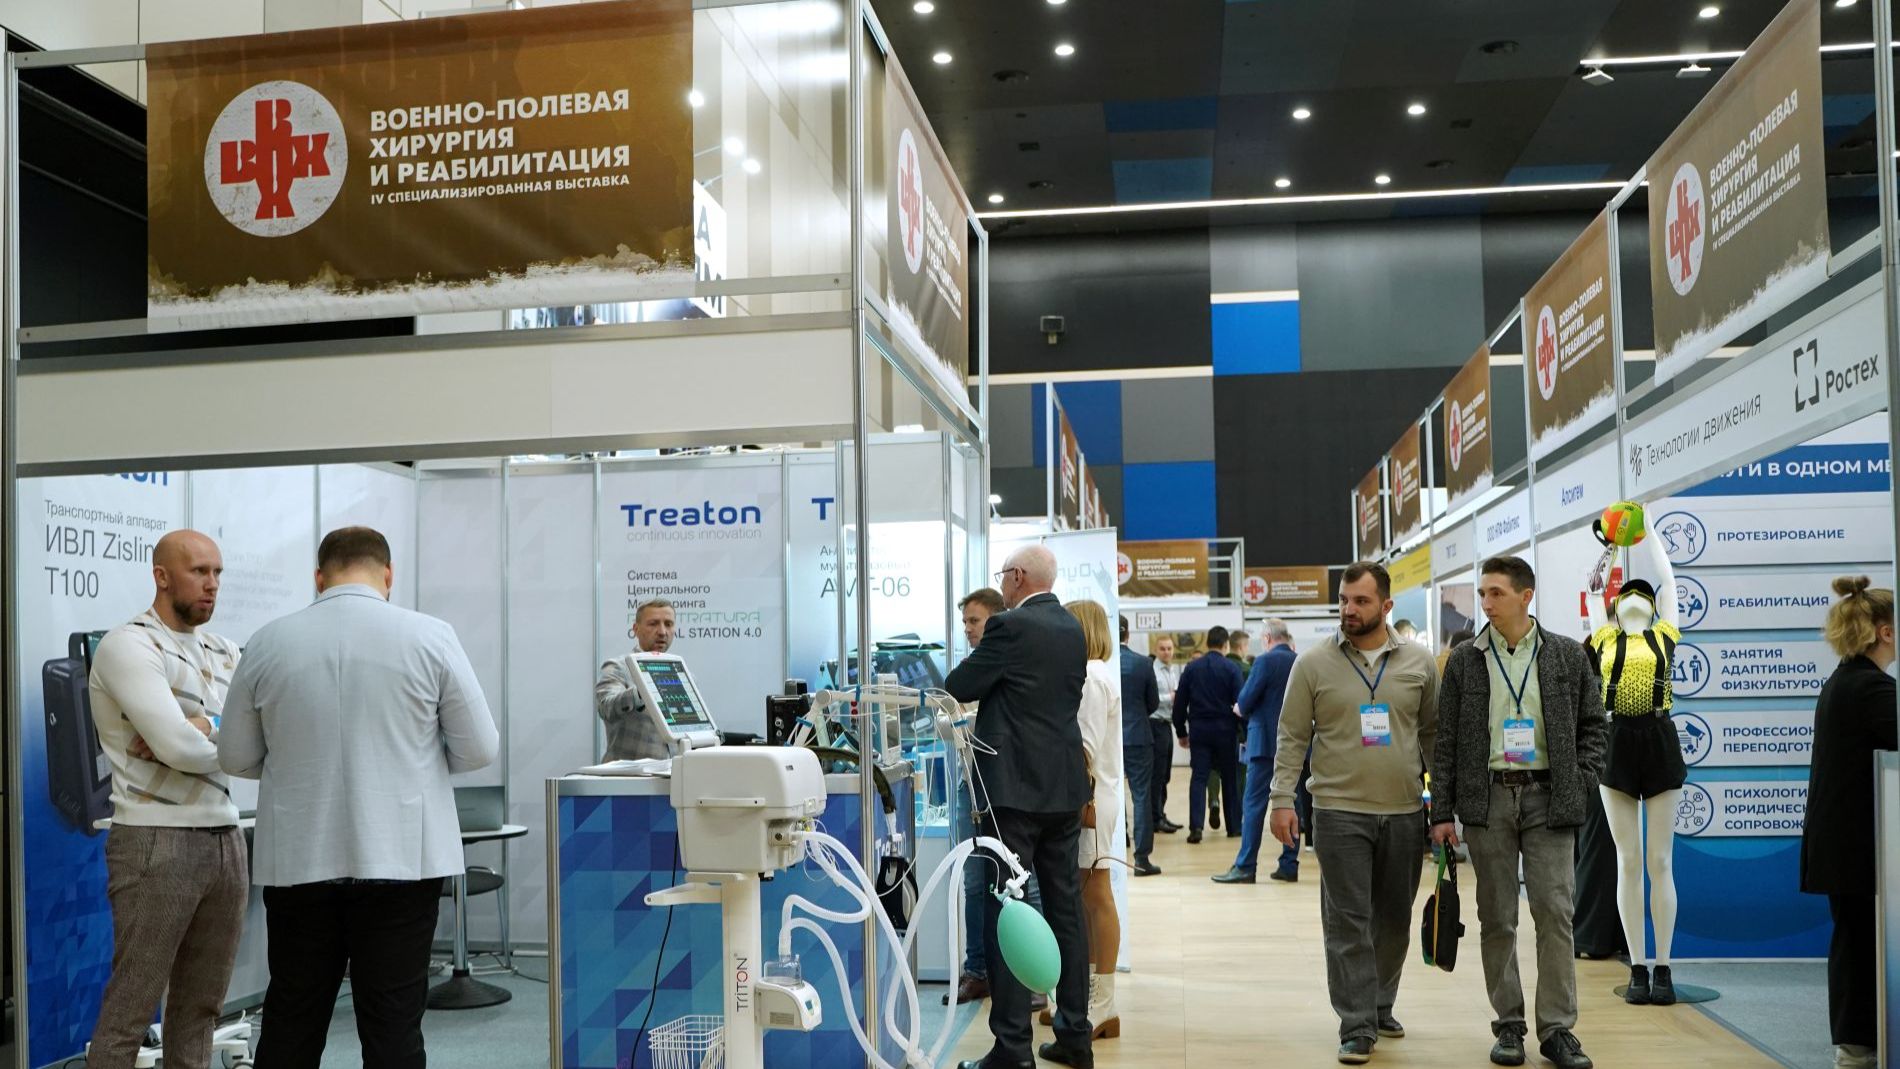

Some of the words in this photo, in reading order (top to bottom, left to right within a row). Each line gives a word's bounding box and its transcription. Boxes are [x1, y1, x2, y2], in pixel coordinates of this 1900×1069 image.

[370, 89, 629, 132] ВОЕННО-ПОЛЕВАЯ
[369, 126, 514, 159] ХИРУРГИЯ
[1709, 88, 1798, 188] ВОЕННО-ПОЛЕВАЯ
[370, 164, 389, 187] И
[397, 145, 630, 184] РЕАБИЛИТАЦИЯ
[370, 193, 384, 205] IV
[387, 180, 552, 204] СПЕЦИАЛИЗИРОВАННАЯ
[555, 174, 630, 191] ВЫСТАВКА
[1711, 153, 1758, 212] ХИРУРГИЯ
[1711, 216, 1719, 235] И
[1720, 143, 1800, 228] РЕАБИЛИТАЦИЯ
[1646, 427, 1700, 467] Технологии
[1703, 394, 1761, 445] движения
[1825, 354, 1879, 399] Ростех
[1767, 462, 1781, 477] В
[1785, 459, 1861, 478] ОДНОМ
[44, 499, 123, 524] Транспортный
[126, 515, 168, 531] аппарат
[620, 500, 761, 527] Treaton
[46, 523, 95, 557] ИВЛ
[627, 528, 695, 542] continuous
[698, 527, 762, 540] innovation
[1717, 529, 1845, 542] ПРОТЕЗИРОВАНИЕ
[627, 569, 678, 581] Система
[627, 584, 711, 597] Центрального
[1719, 596, 1829, 609] РЕАБИЛИТАЦИЯ
[688, 627, 741, 638] STATION
[744, 626, 762, 638] 4.0
[1720, 649, 1783, 660] ЗАНЯТИЯ
[1721, 662, 1817, 676] АДАПТИВНОЙ
[1723, 742, 1814, 754] ПЕРЕПОДГОТ
